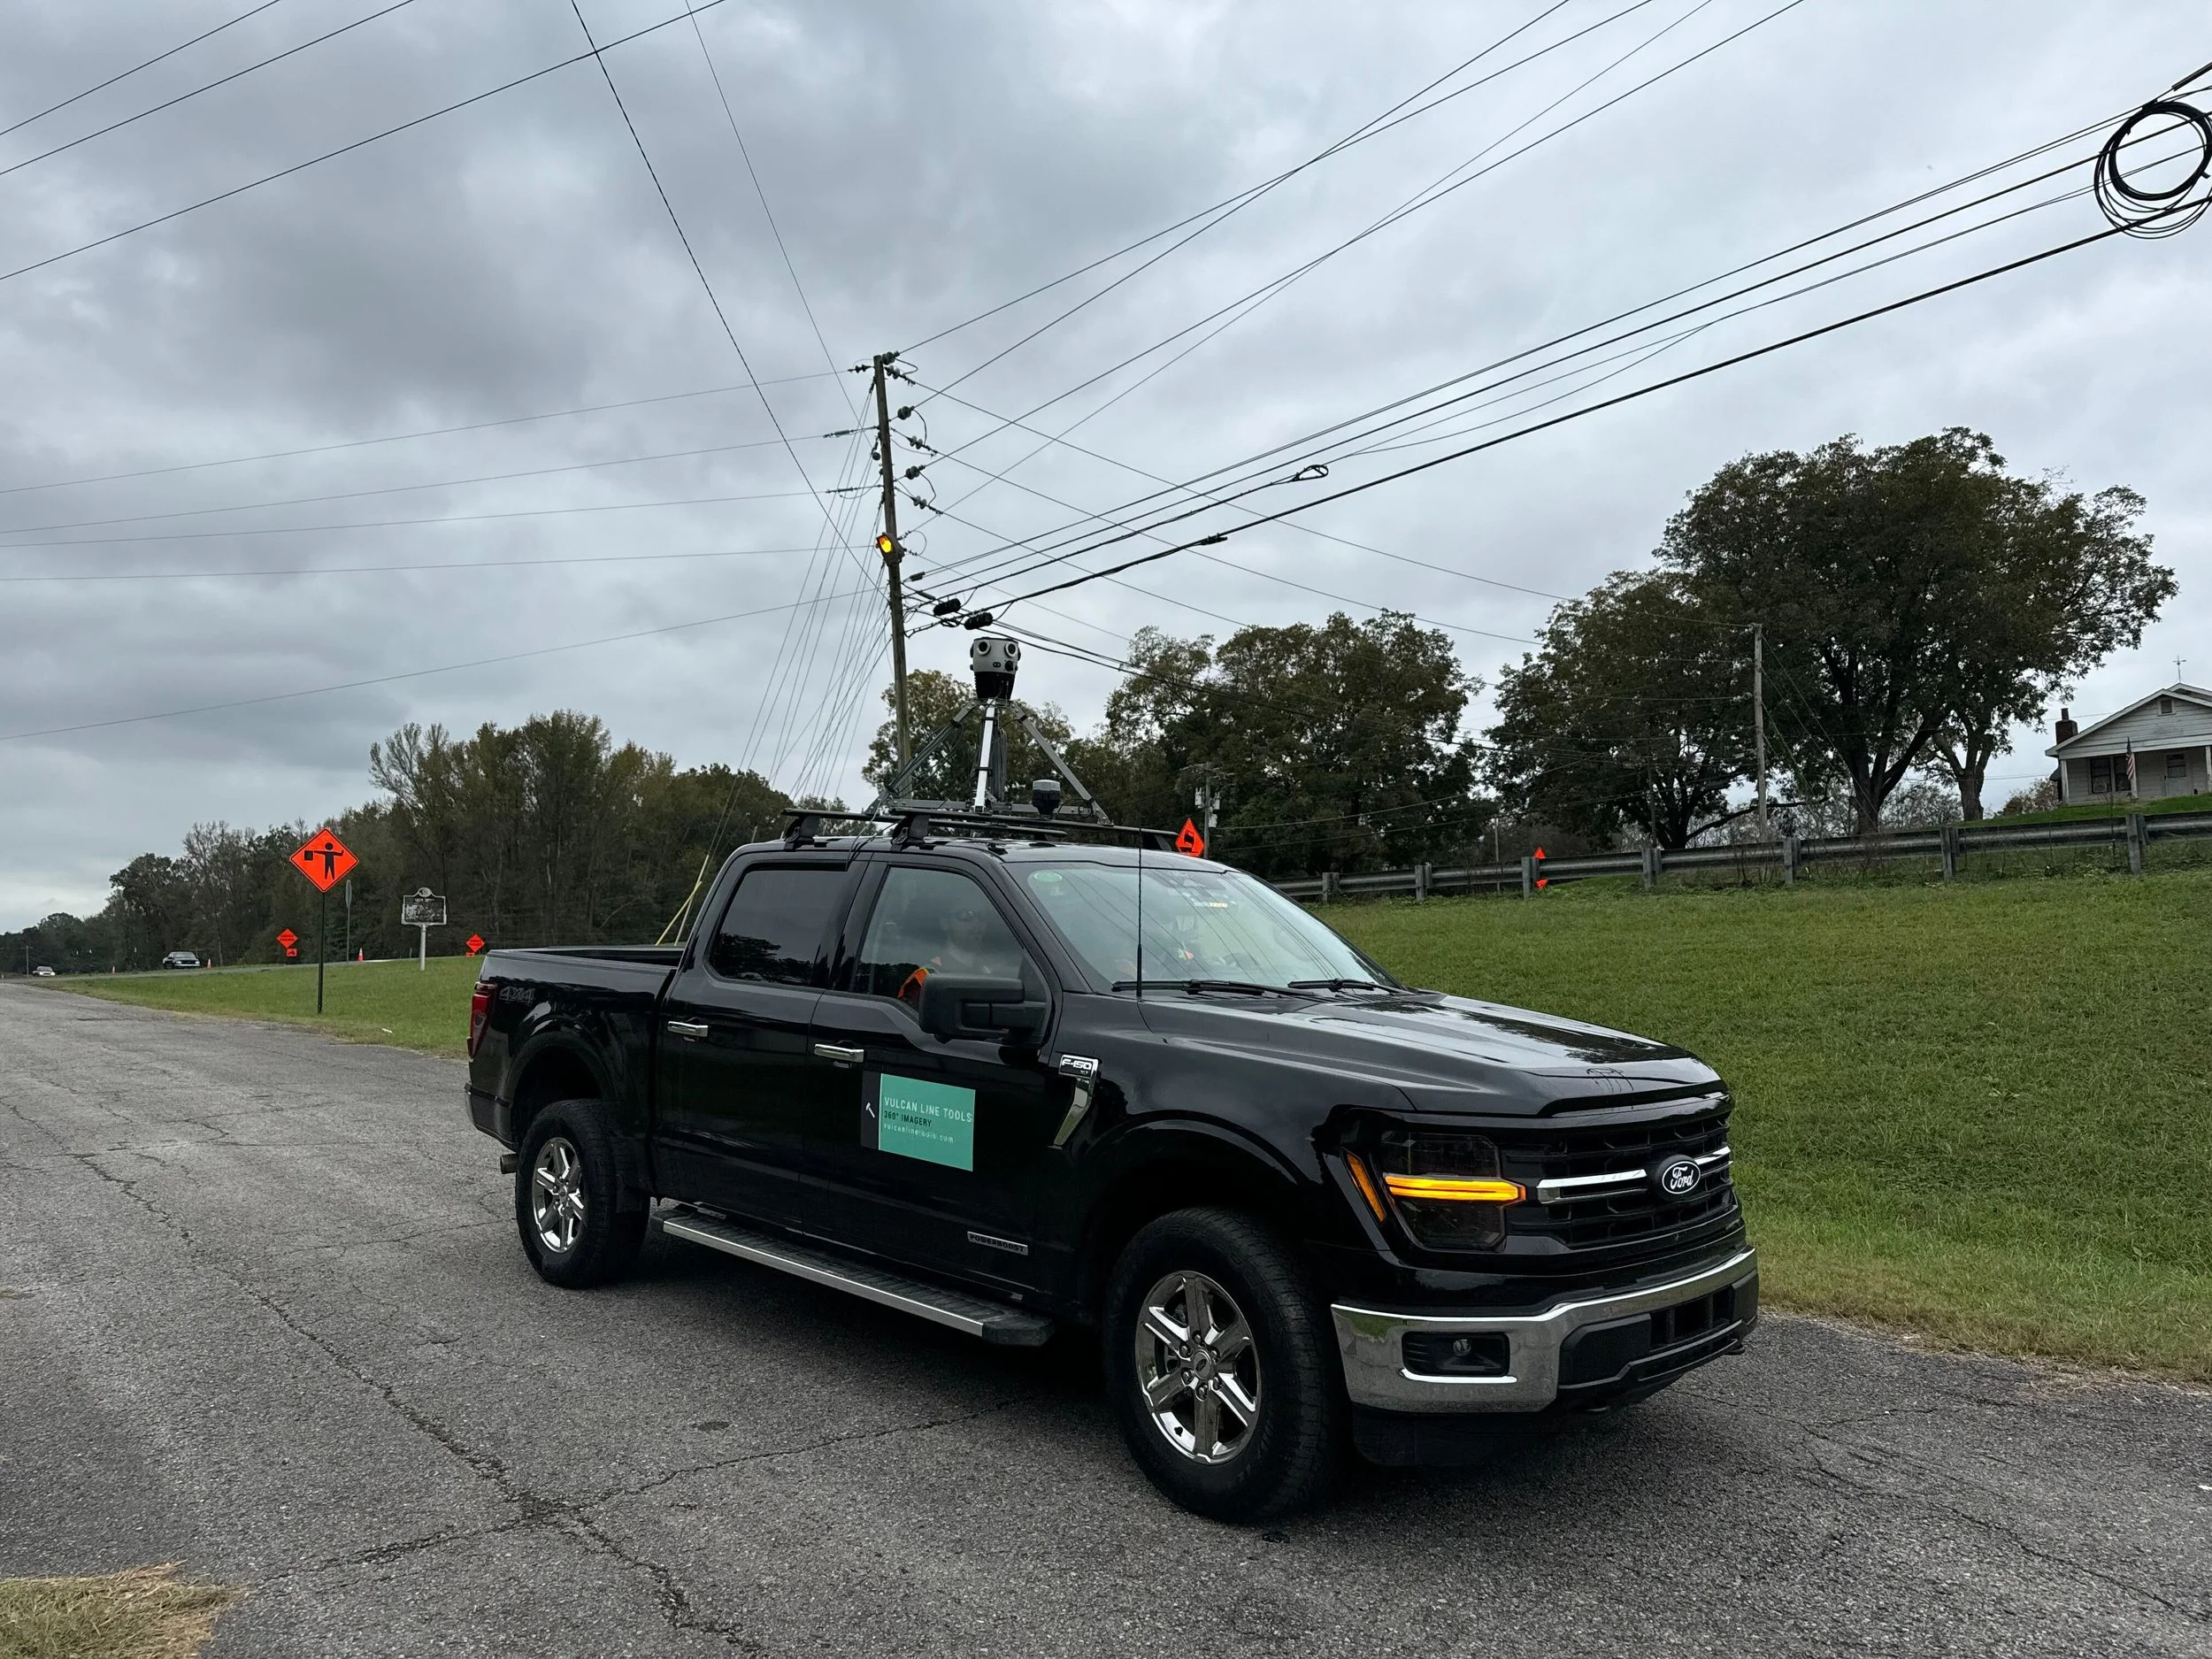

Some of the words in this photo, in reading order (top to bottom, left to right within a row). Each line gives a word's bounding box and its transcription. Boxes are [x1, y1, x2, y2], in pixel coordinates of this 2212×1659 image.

[1062, 1058, 1092, 1071] F-150
[884, 1096, 918, 1112] VULCAN
[920, 1103, 940, 1117] LINE
[942, 1108, 972, 1123] TOOLS
[884, 1110, 899, 1120] 360°
[901, 1113, 932, 1127] IMAGERY
[1670, 1165, 1694, 1190] Ford
